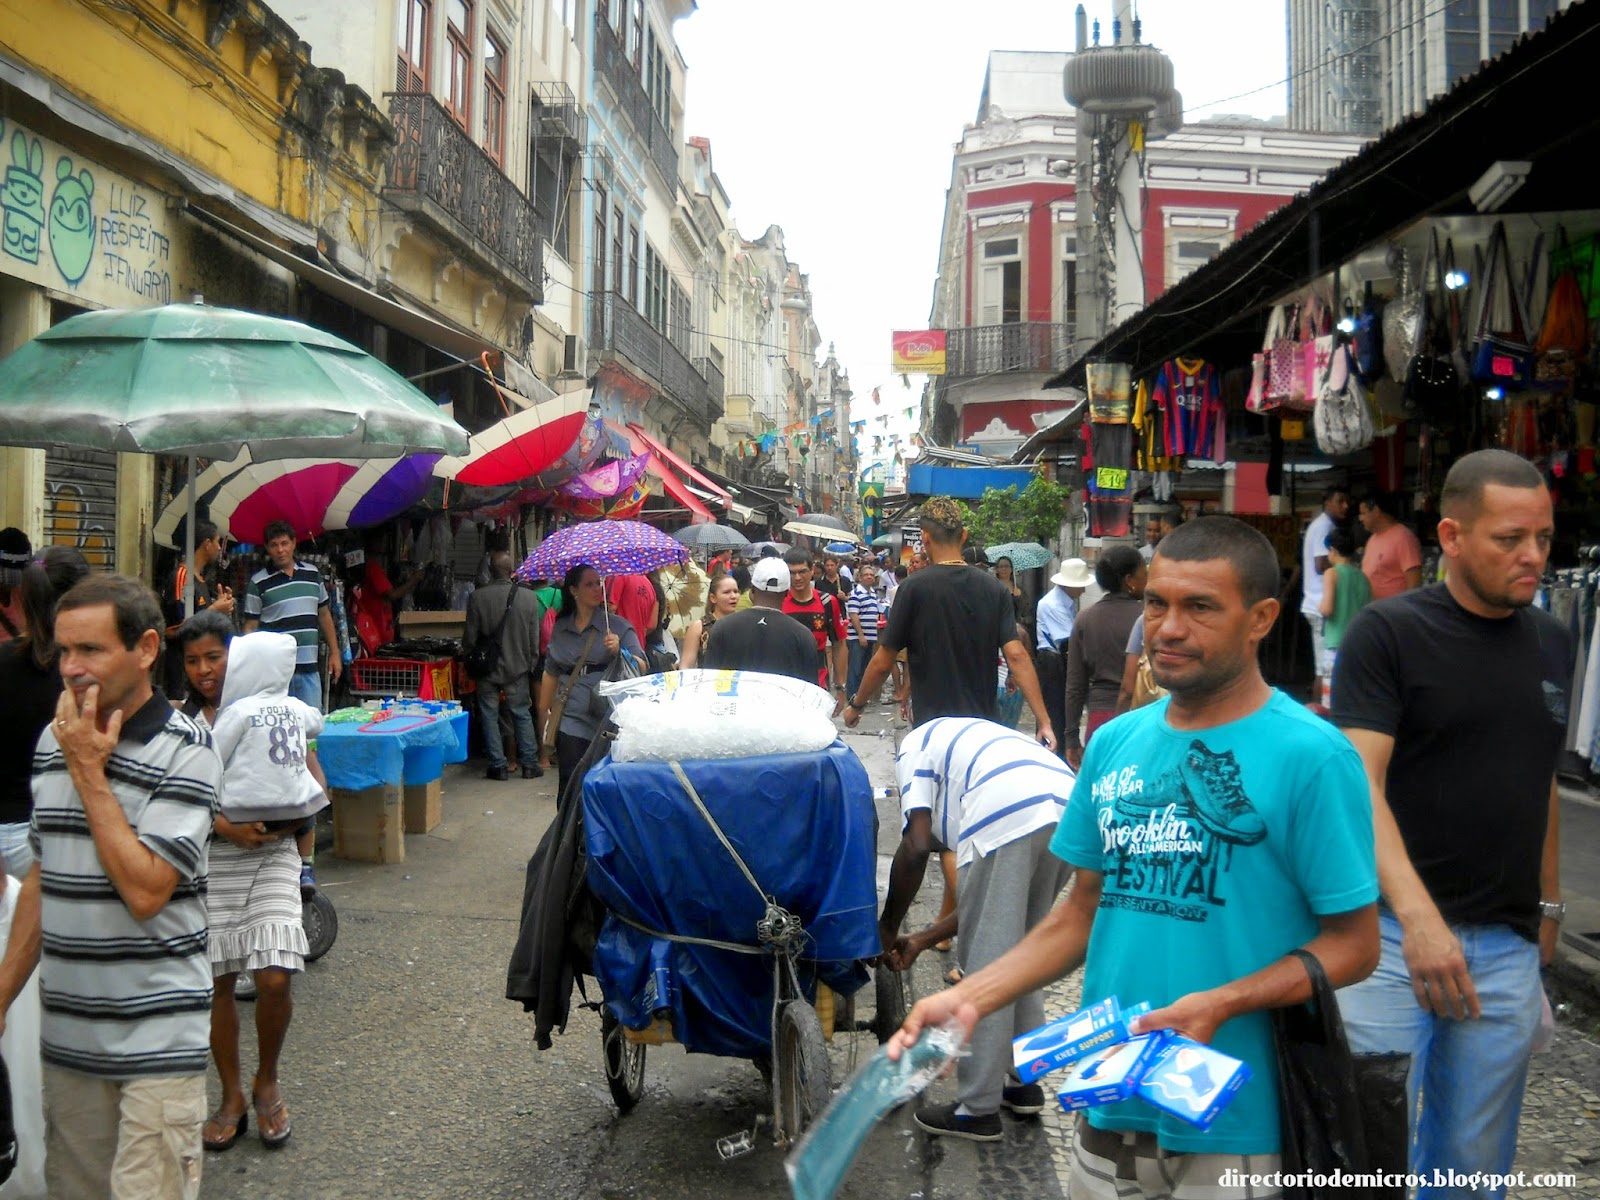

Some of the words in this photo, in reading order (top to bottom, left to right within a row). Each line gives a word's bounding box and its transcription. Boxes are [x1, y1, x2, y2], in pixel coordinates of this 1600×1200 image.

[269, 725, 305, 765] 83
[1119, 764, 1139, 787] OF
[1098, 802, 1191, 854] Brooklin
[1054, 1047, 1078, 1062] KNEE
[1079, 1029, 1115, 1051] SUPPORT
